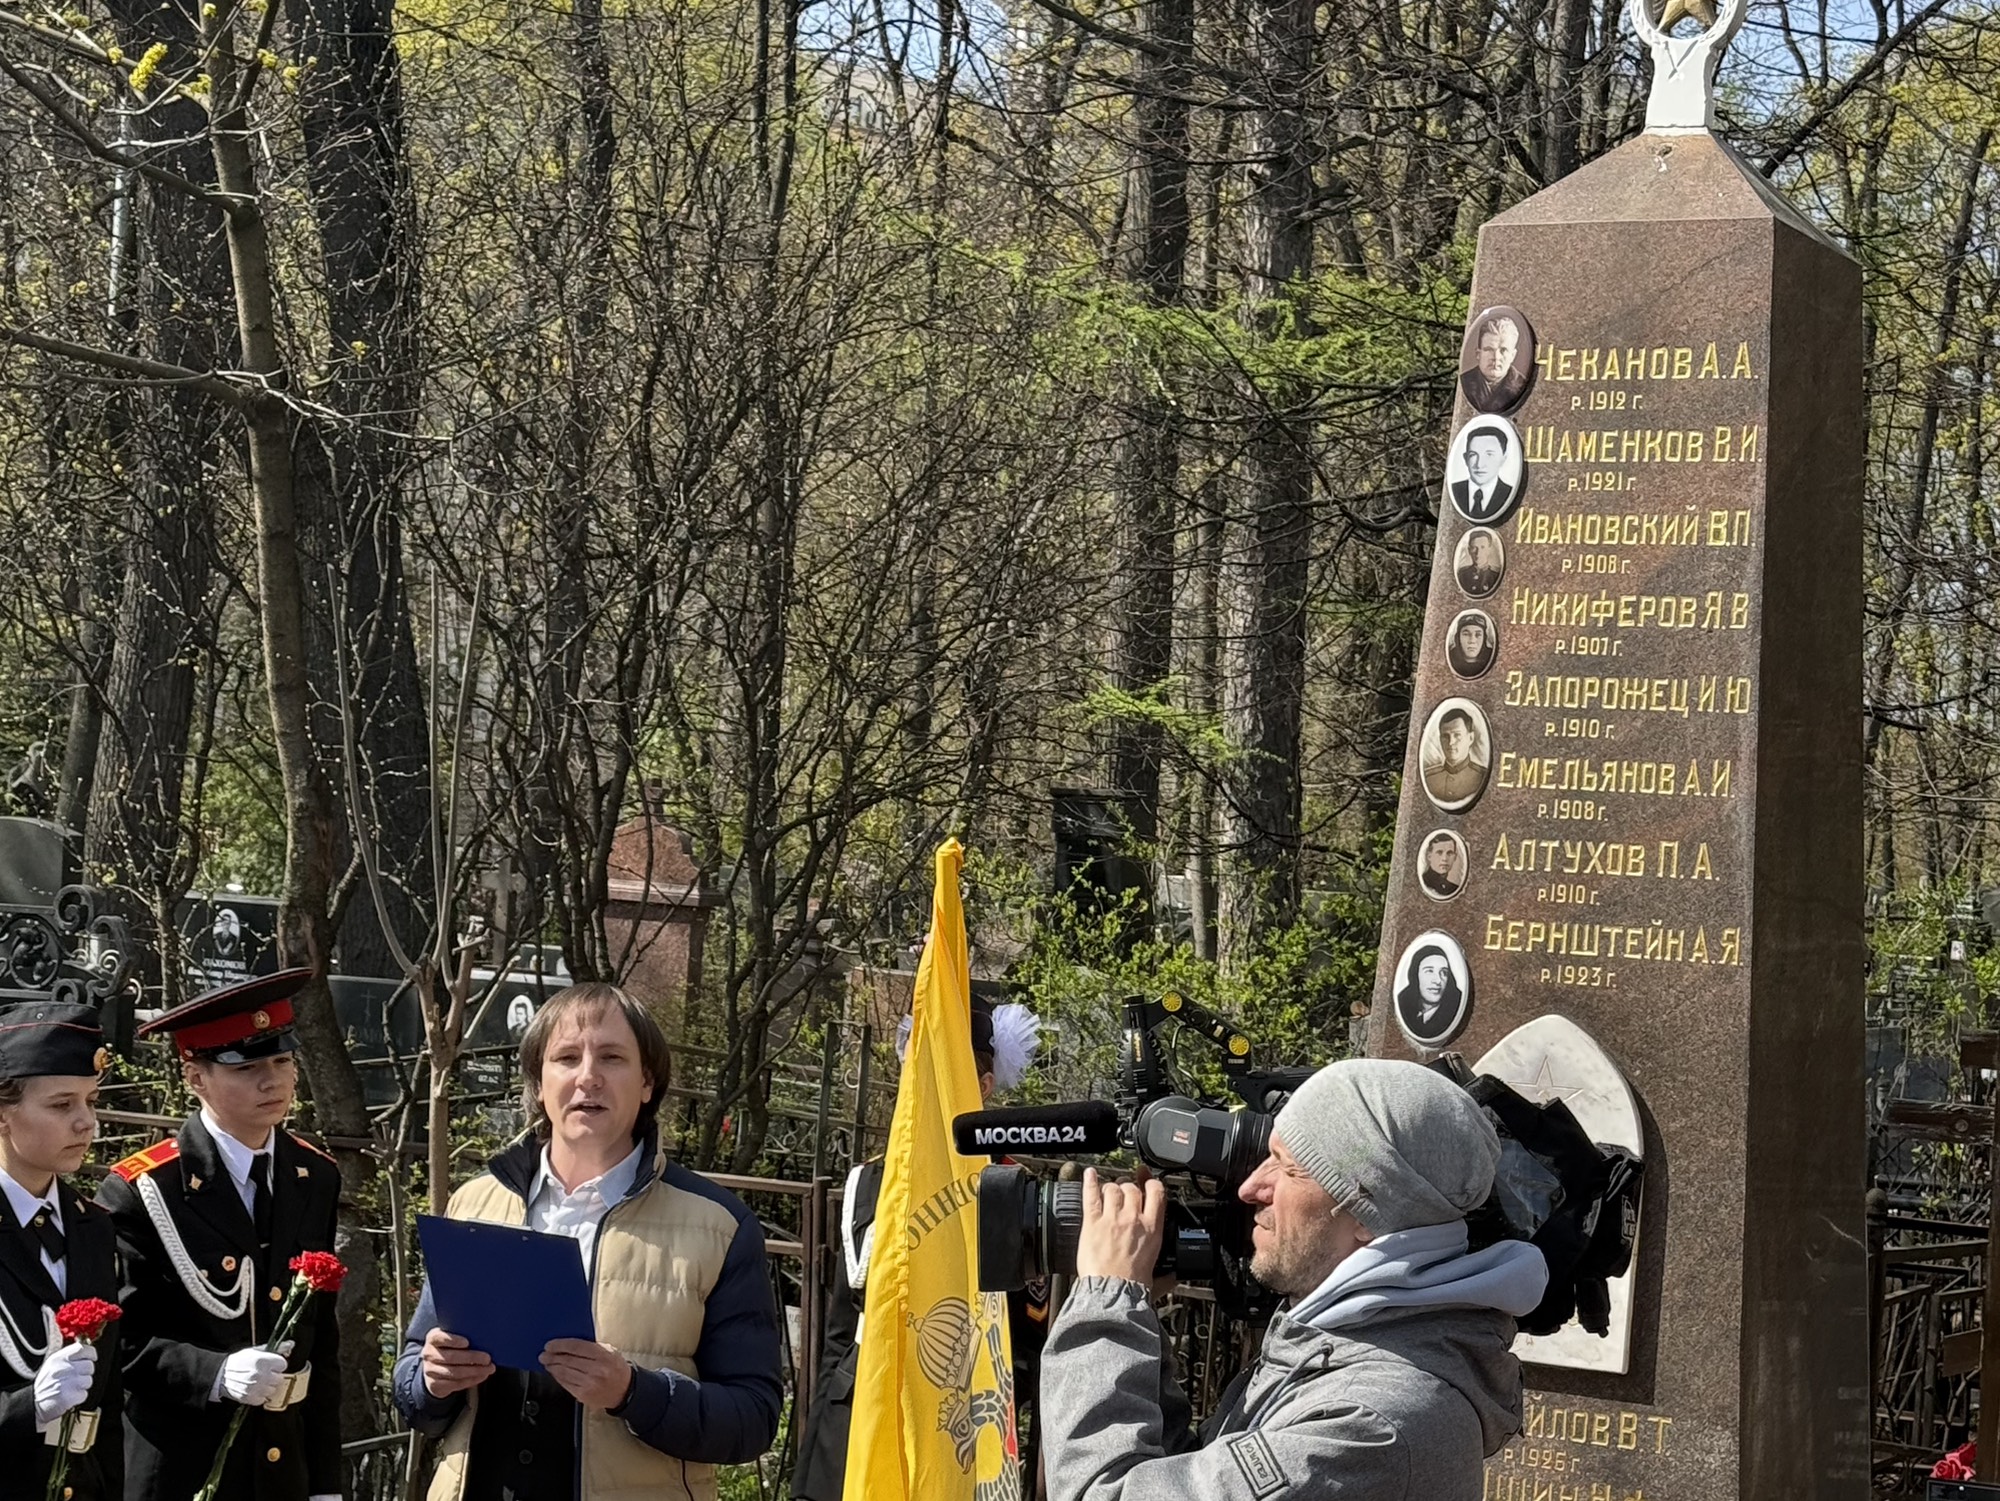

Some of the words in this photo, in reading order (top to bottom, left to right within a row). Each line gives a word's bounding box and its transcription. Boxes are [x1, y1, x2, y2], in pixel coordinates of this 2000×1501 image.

[1534, 343, 1693, 381] ЧЕКАНОВ
[1523, 426, 1704, 463] ШАМЕНКОВ
[1515, 504, 1699, 546] ИВАНОВСКИЙ
[1510, 586, 1698, 628] НИКИФЕРОВ
[1504, 670, 1689, 719] ЗАПОРОЖЕЦ
[1497, 752, 1676, 796] ЕМЕЛЬЯНОВ
[1490, 832, 1645, 877] АЛТУХОВ
[1483, 914, 1685, 962] БЕРНШТЕЙН
[1526, 1393, 1610, 1447] ЙЛОВ
